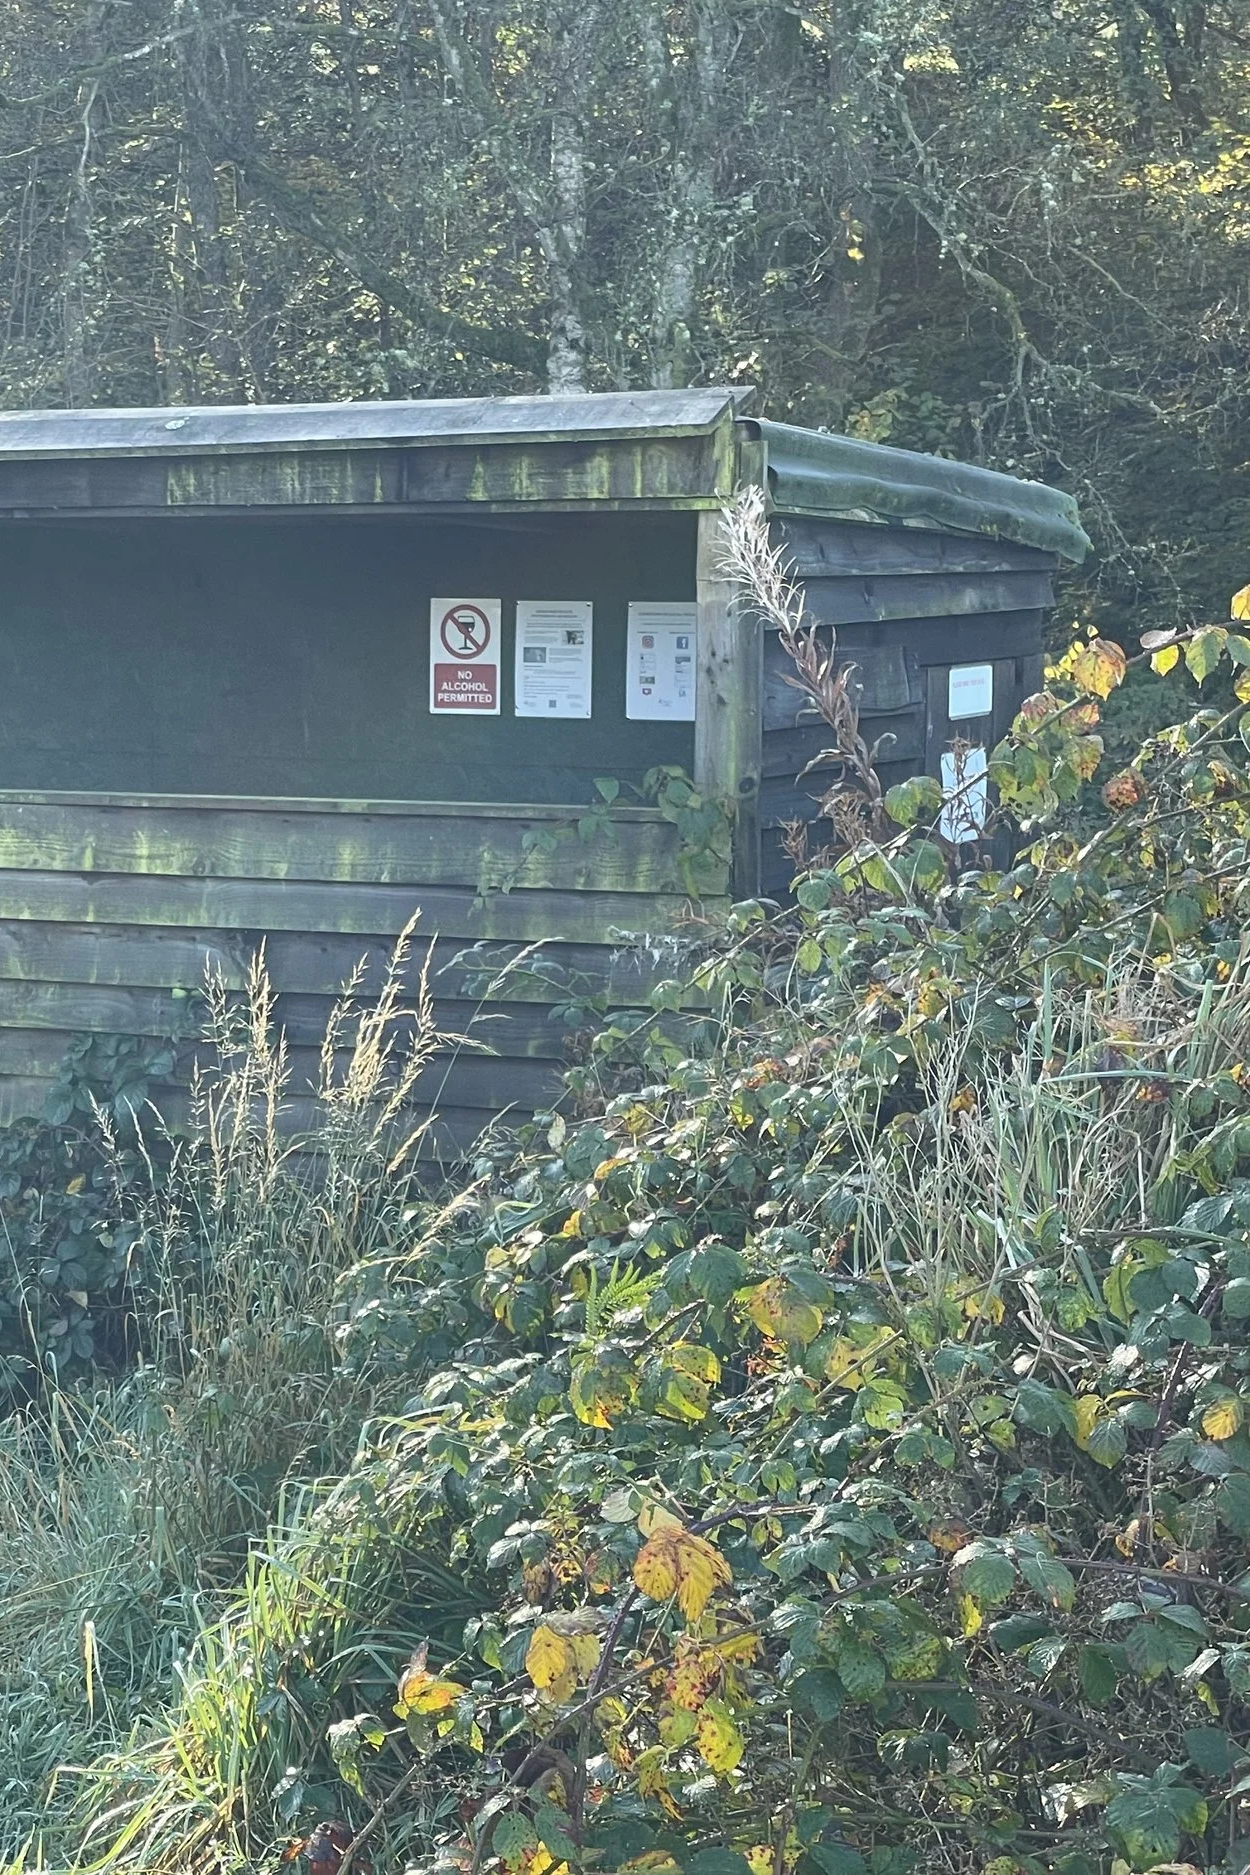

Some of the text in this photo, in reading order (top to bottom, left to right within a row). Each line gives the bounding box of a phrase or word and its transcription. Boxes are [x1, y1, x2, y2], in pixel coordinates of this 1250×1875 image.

[457, 670, 473, 680] NO
[441, 681, 489, 692] ALCOHOL
[437, 693, 493, 703] PERMITTED
